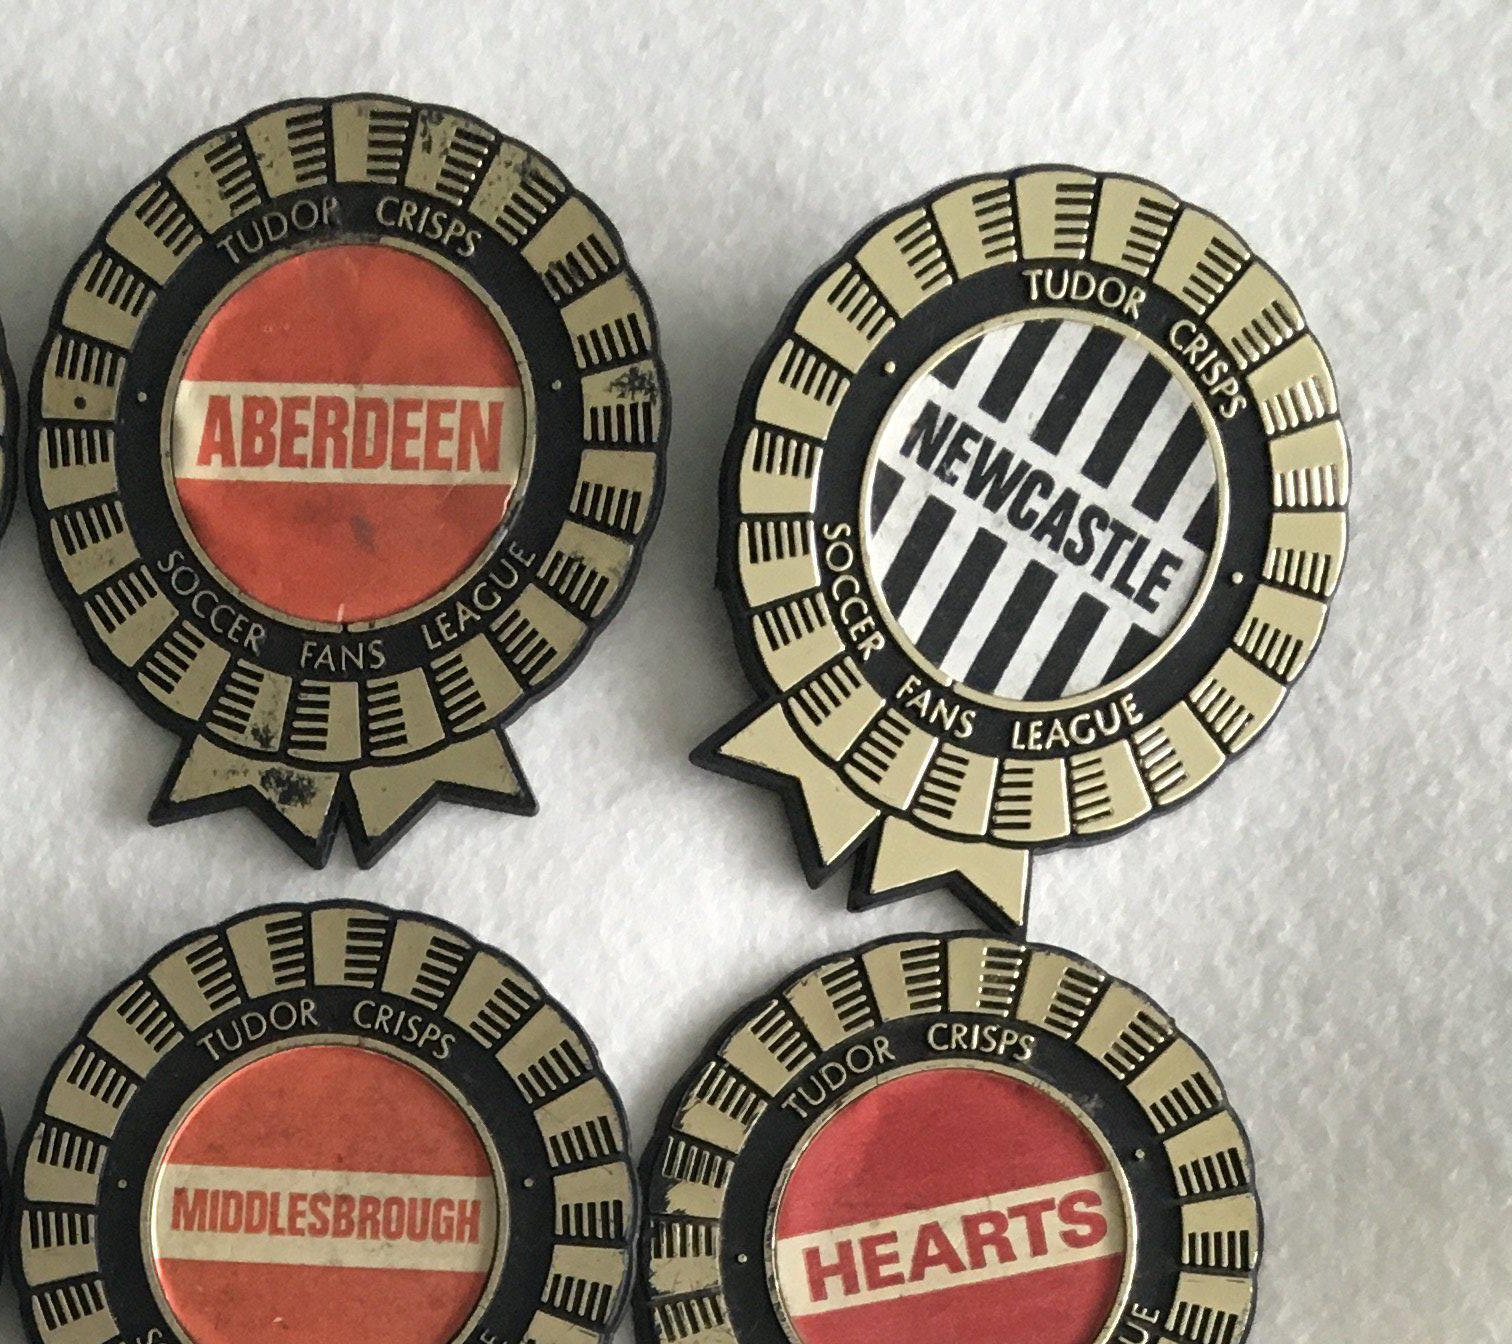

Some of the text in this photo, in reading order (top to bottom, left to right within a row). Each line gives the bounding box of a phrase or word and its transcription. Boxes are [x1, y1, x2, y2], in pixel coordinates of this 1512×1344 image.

[217, 196, 482, 263] TUDOR CRISPS
[1022, 268, 1247, 420] TUDOR CRISPS
[196, 394, 504, 473] ABERDEEN
[899, 399, 1184, 615] NEWCASTLE
[157, 540, 537, 670] SOCCER FANS LEAGUE
[822, 523, 1145, 751] SOCCER FANS LEAGUE
[196, 1000, 457, 1061] TUDOR CRISPS
[781, 1022, 1036, 1119] TUDOR CRISPS
[170, 1186, 481, 1244] MIDDLESBROUGH
[801, 1189, 1108, 1303] HEARTS
